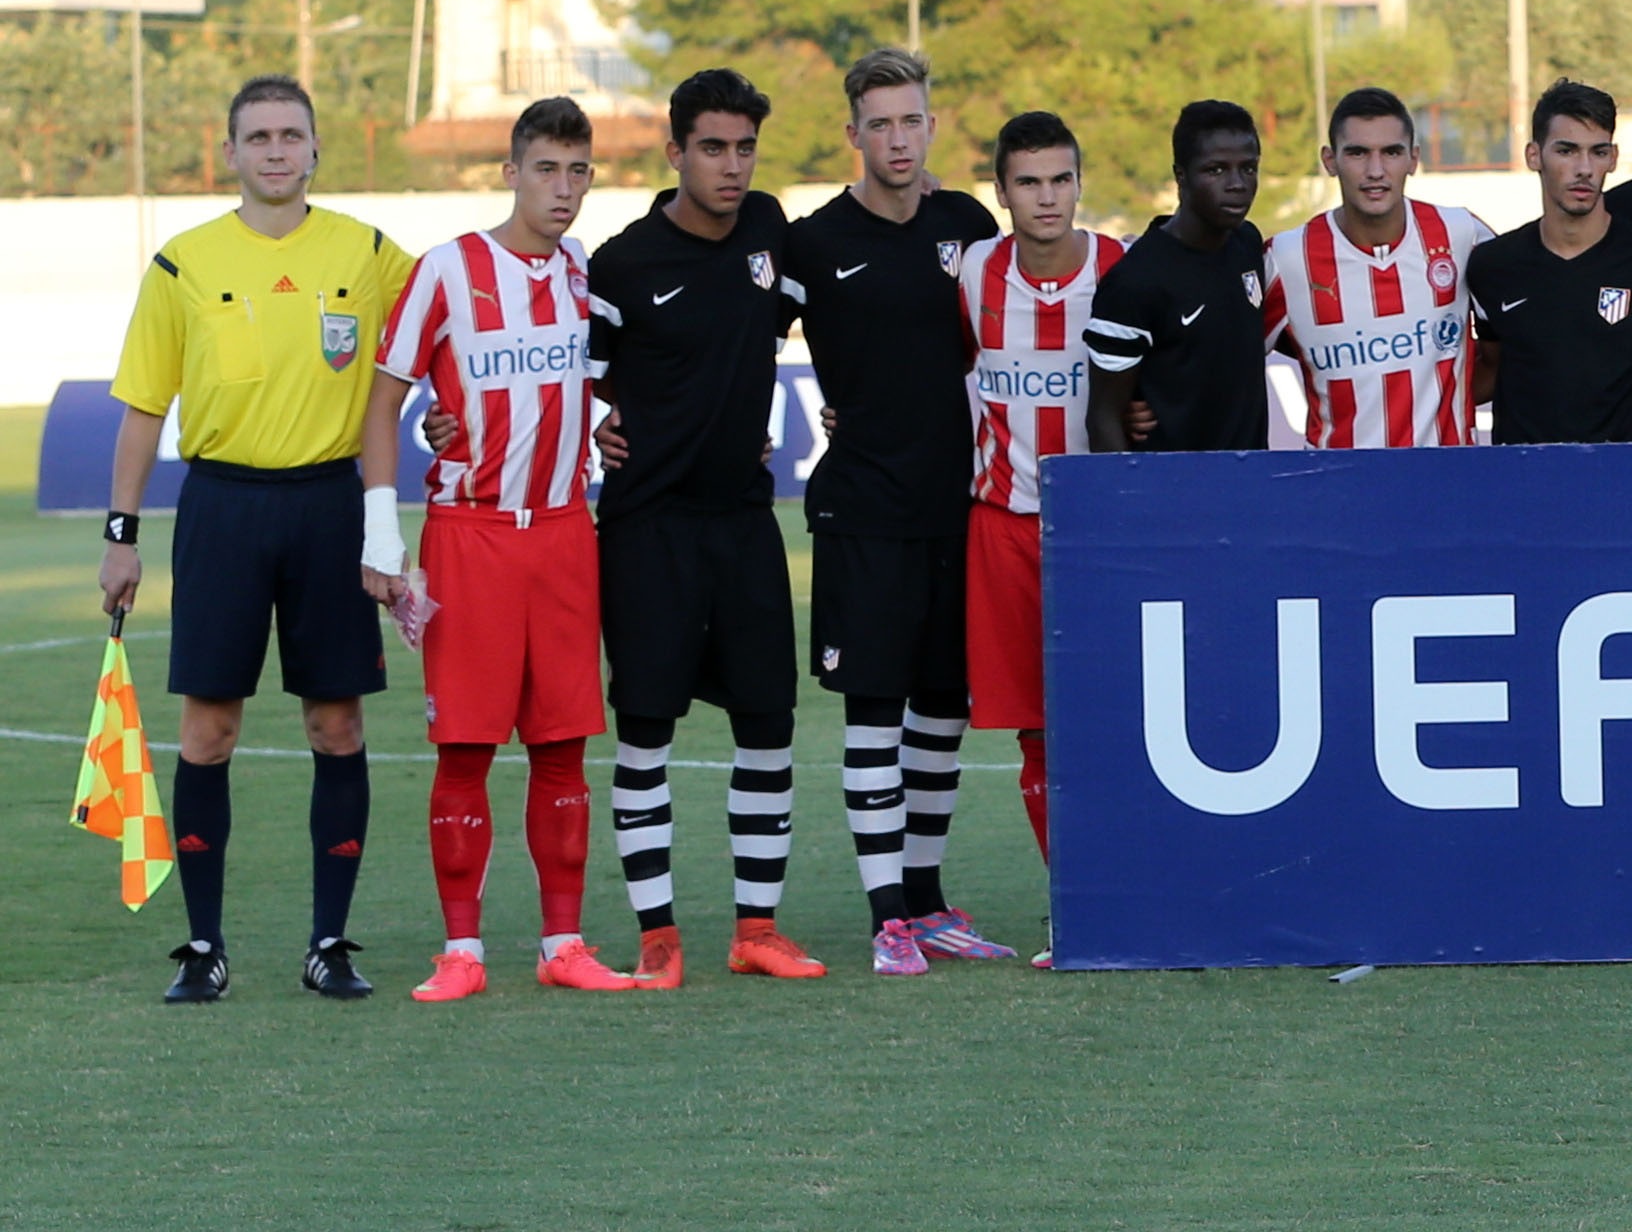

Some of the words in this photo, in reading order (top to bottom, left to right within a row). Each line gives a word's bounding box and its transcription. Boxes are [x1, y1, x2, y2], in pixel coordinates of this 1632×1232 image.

[467, 333, 578, 380] unicef
[1309, 319, 1428, 371] unicef
[978, 361, 1085, 398] unicef
